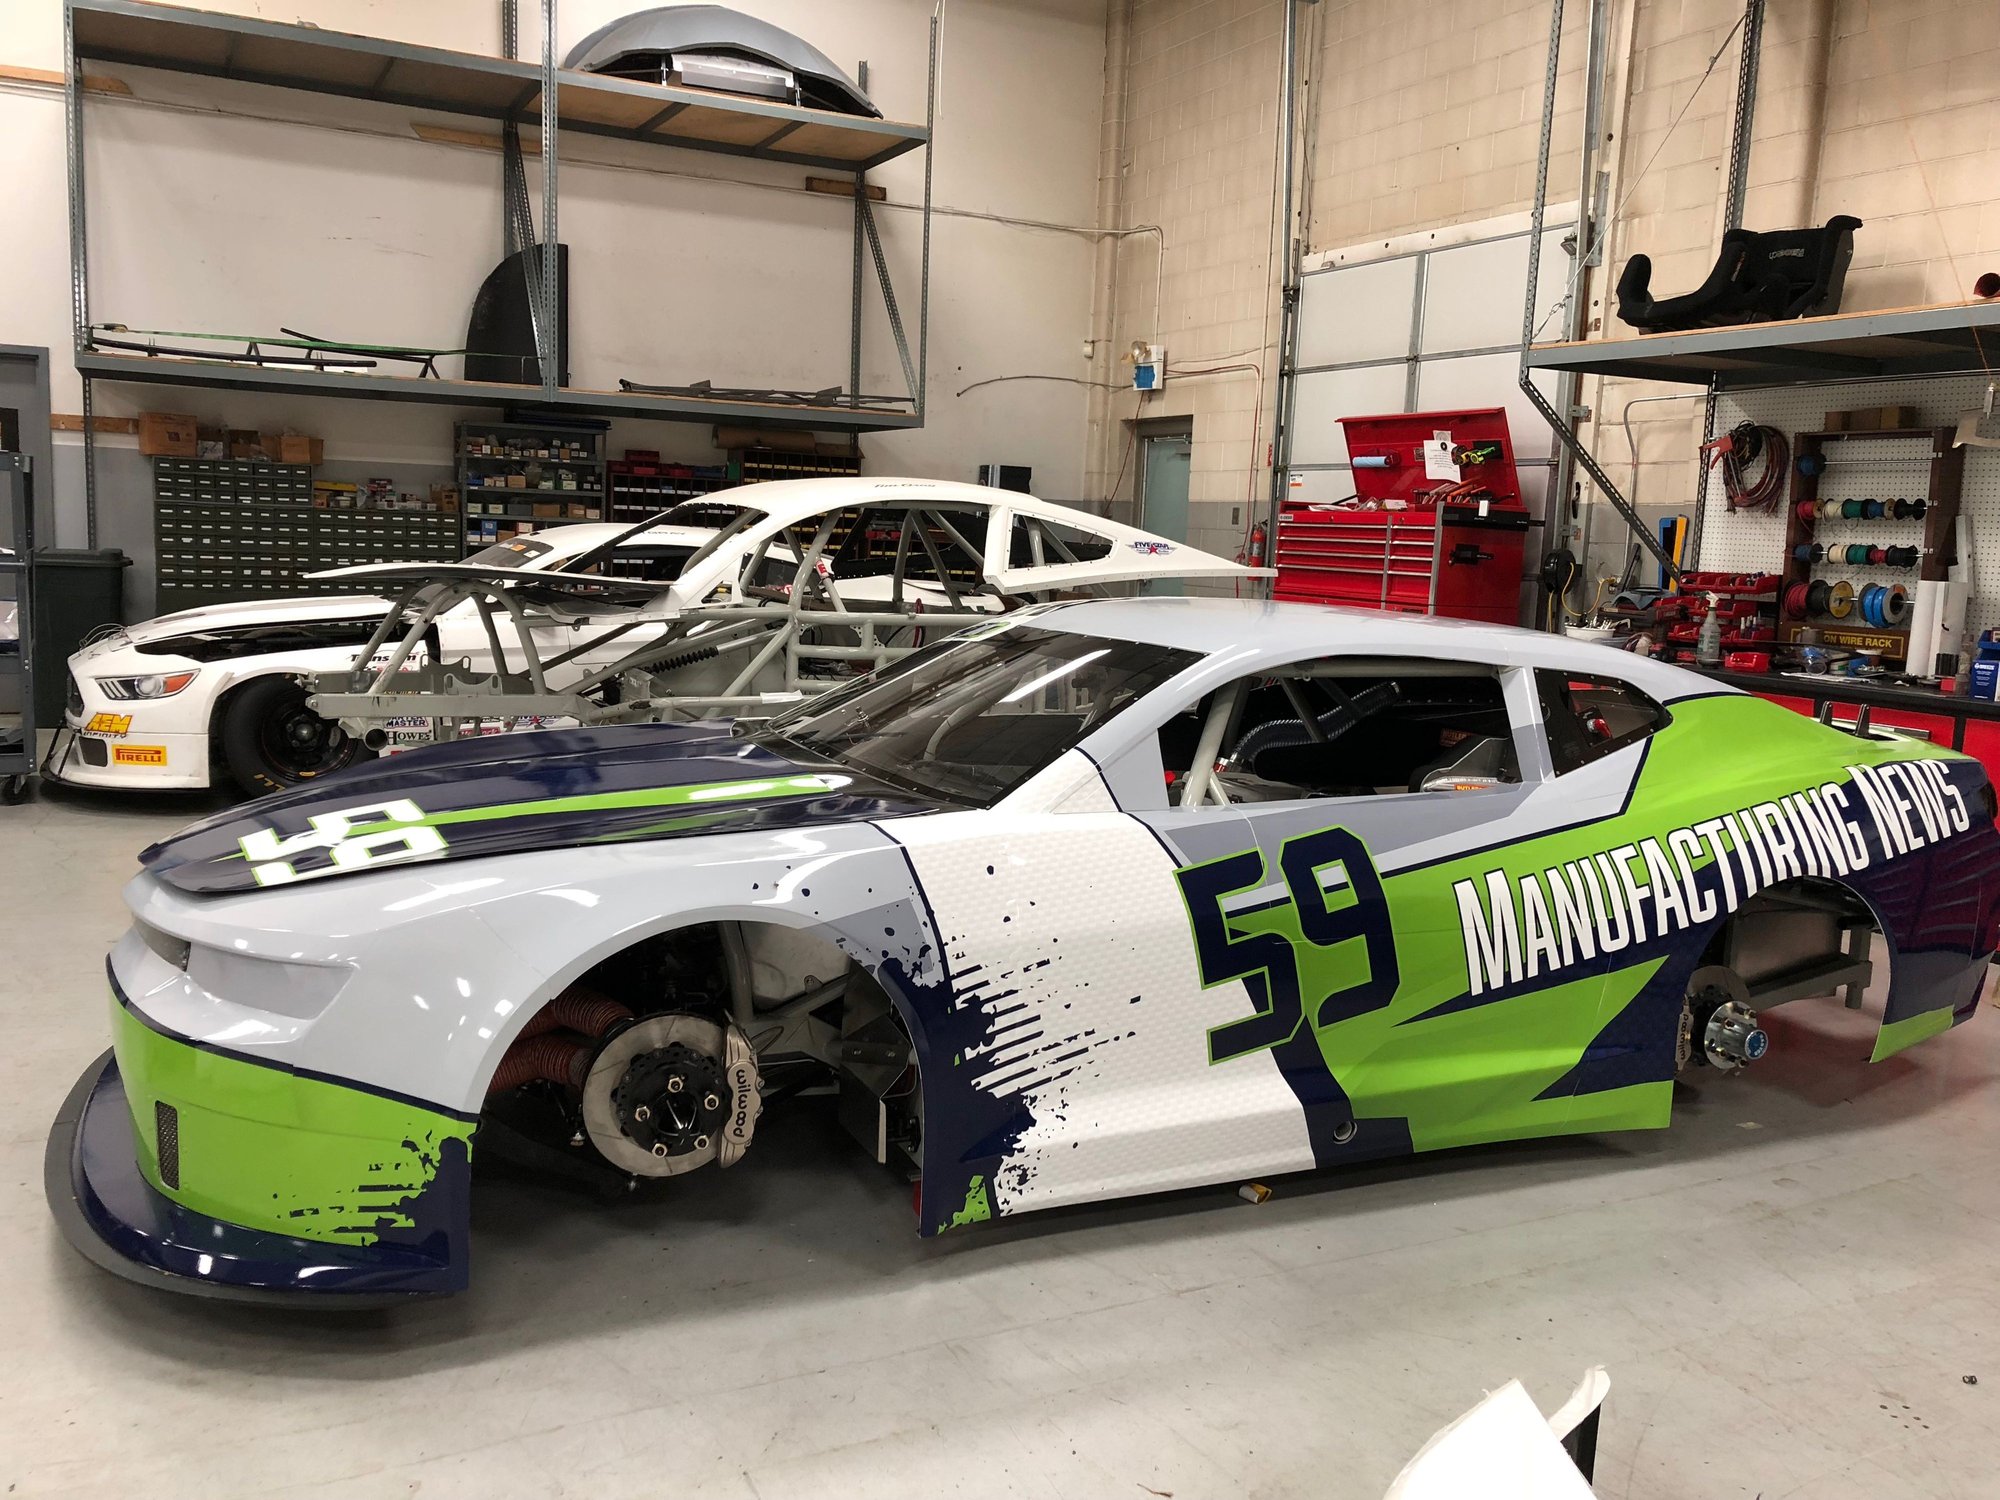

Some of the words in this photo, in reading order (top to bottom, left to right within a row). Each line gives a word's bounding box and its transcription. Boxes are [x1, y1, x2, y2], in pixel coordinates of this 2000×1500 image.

[1839, 636, 1863, 646] WIRE
[1865, 638, 1892, 648] RACK
[84, 711, 134, 735] AEM
[385, 719, 426, 728] MASTER
[115, 748, 162, 762] PIRELLI
[1452, 782, 1871, 997] MANUFACTURING
[1846, 759, 1970, 860] NEWS
[1173, 825, 1400, 1066] 59
[733, 1069, 751, 1138] wilwood
